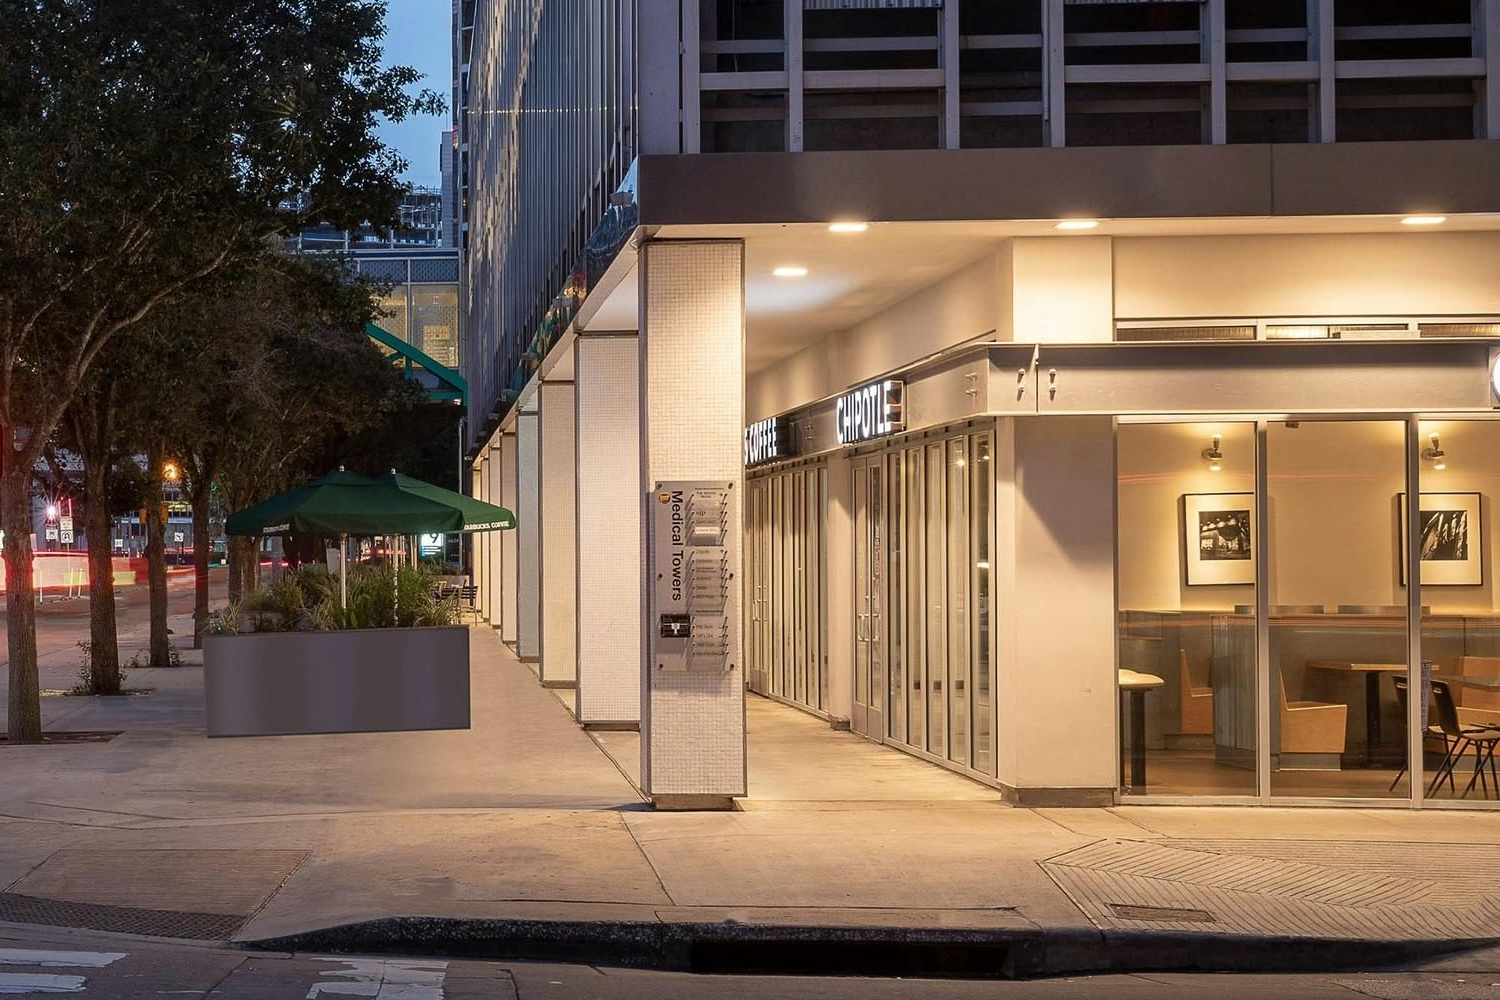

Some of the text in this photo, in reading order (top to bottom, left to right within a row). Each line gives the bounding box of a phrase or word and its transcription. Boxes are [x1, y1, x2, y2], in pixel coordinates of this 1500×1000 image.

[836, 380, 892, 444] CHIPOTLE
[750, 417, 777, 463] COFFEE
[430, 532, 439, 544] 9
[671, 490, 684, 546] Medical
[671, 550, 684, 601] Towers
